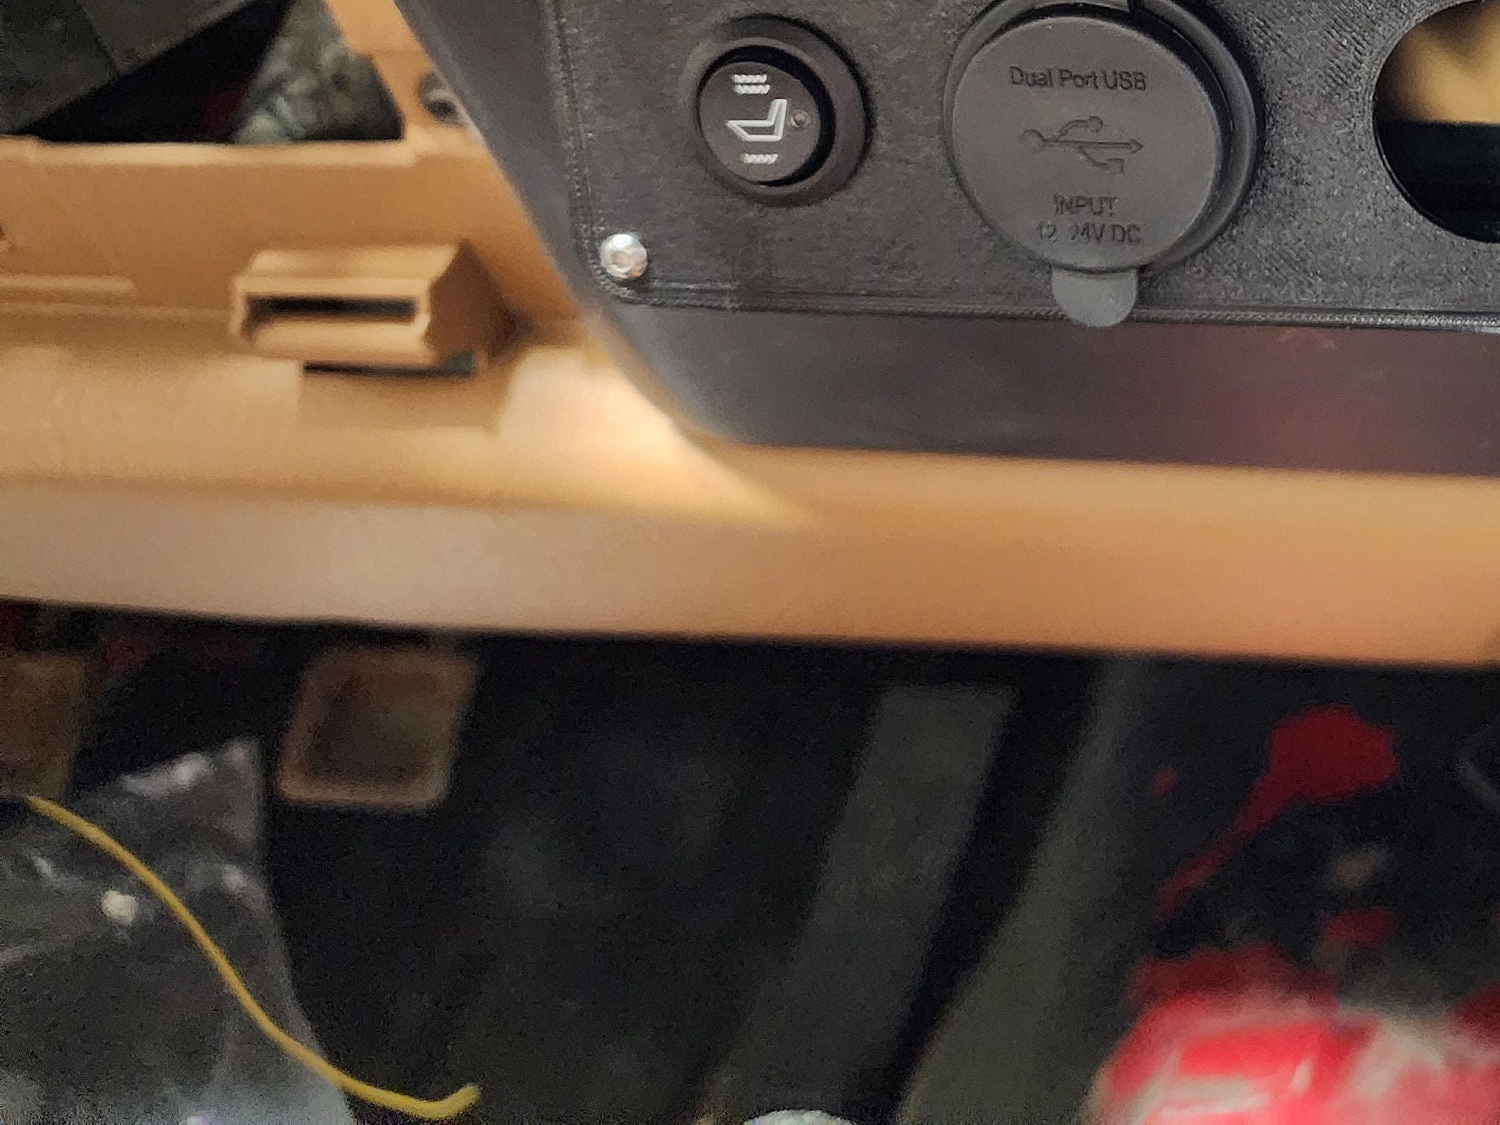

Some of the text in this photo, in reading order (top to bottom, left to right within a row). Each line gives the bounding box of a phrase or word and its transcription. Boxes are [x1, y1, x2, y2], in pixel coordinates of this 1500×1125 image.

[1009, 65, 1147, 92] Dual Port USB
[1052, 192, 1120, 217] INPUT
